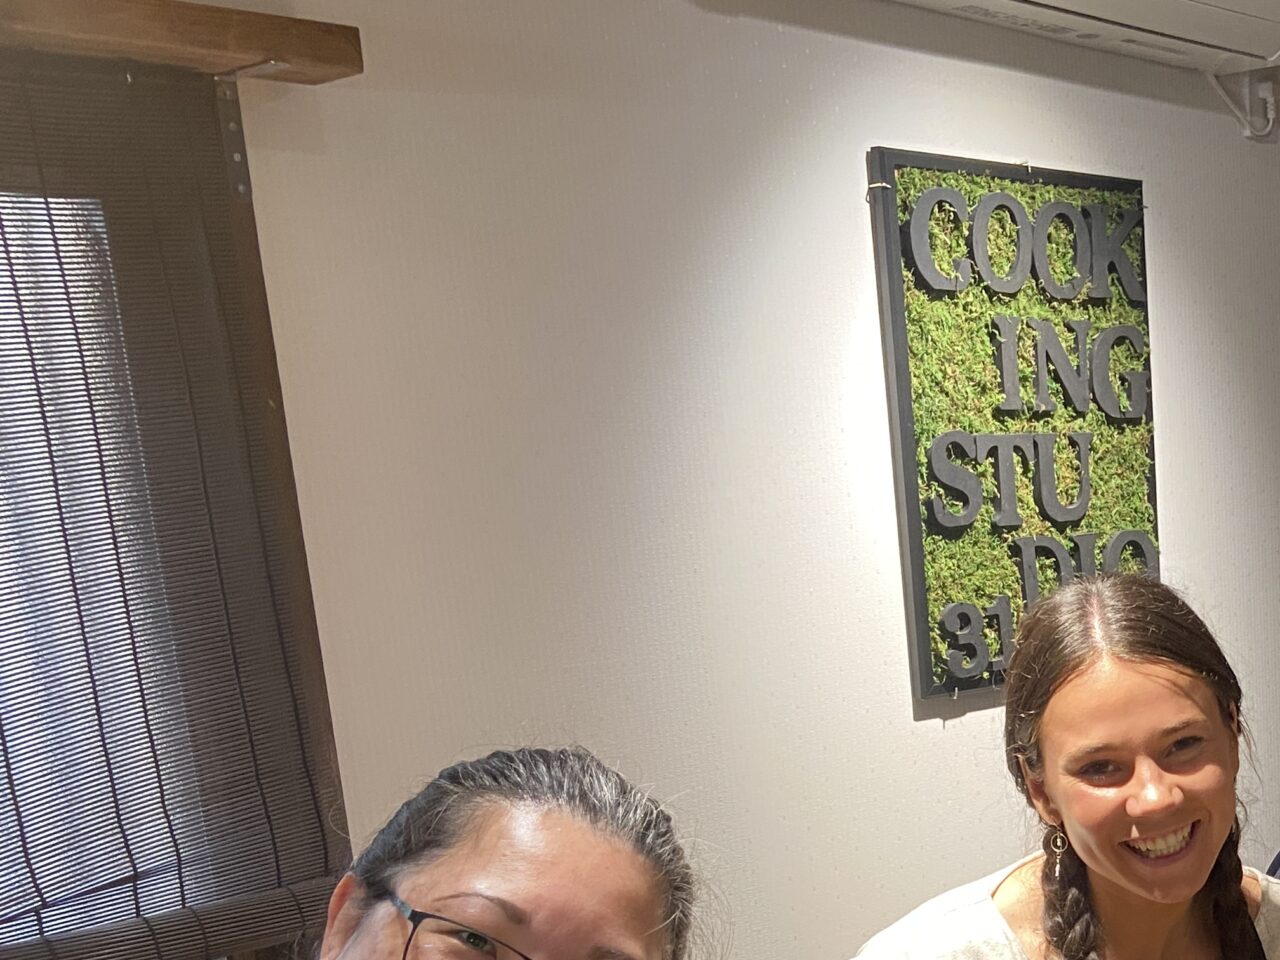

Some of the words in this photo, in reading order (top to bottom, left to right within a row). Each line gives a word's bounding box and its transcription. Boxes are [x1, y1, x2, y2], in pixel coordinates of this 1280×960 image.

[910, 187, 1146, 300] COOK
[993, 315, 1149, 418] ING
[928, 430, 1092, 528] STU
